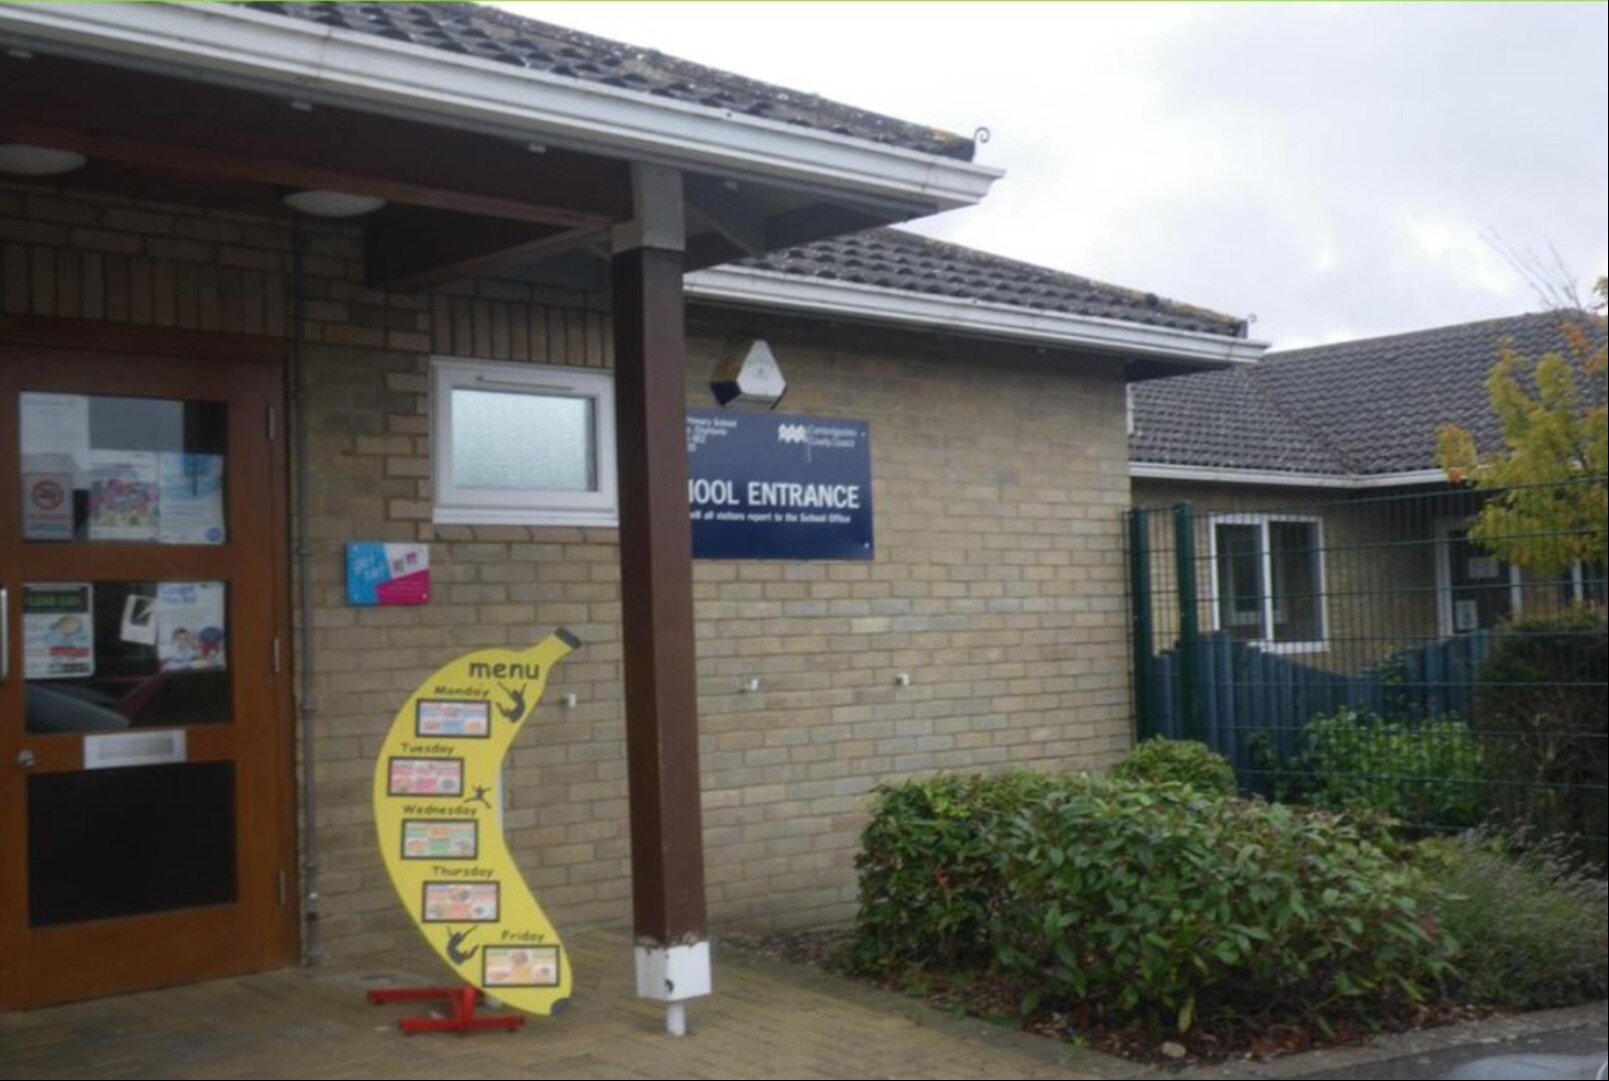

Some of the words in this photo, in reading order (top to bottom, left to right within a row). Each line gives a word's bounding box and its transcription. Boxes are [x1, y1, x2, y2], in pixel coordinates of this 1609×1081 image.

[688, 478, 740, 505] OOL
[748, 482, 860, 508] ENTRANCE
[704, 511, 714, 520] all
[717, 511, 744, 521] visitors
[748, 512, 771, 523] report
[775, 513, 783, 521] to
[785, 513, 797, 522] the
[799, 514, 826, 523] School
[828, 515, 851, 524] Office
[469, 661, 540, 680] menu
[434, 685, 490, 698] Monday
[402, 742, 455, 756] Tuesday
[402, 804, 478, 817] Wednesday
[432, 865, 494, 878] Thursday
[502, 930, 546, 943] Friday
